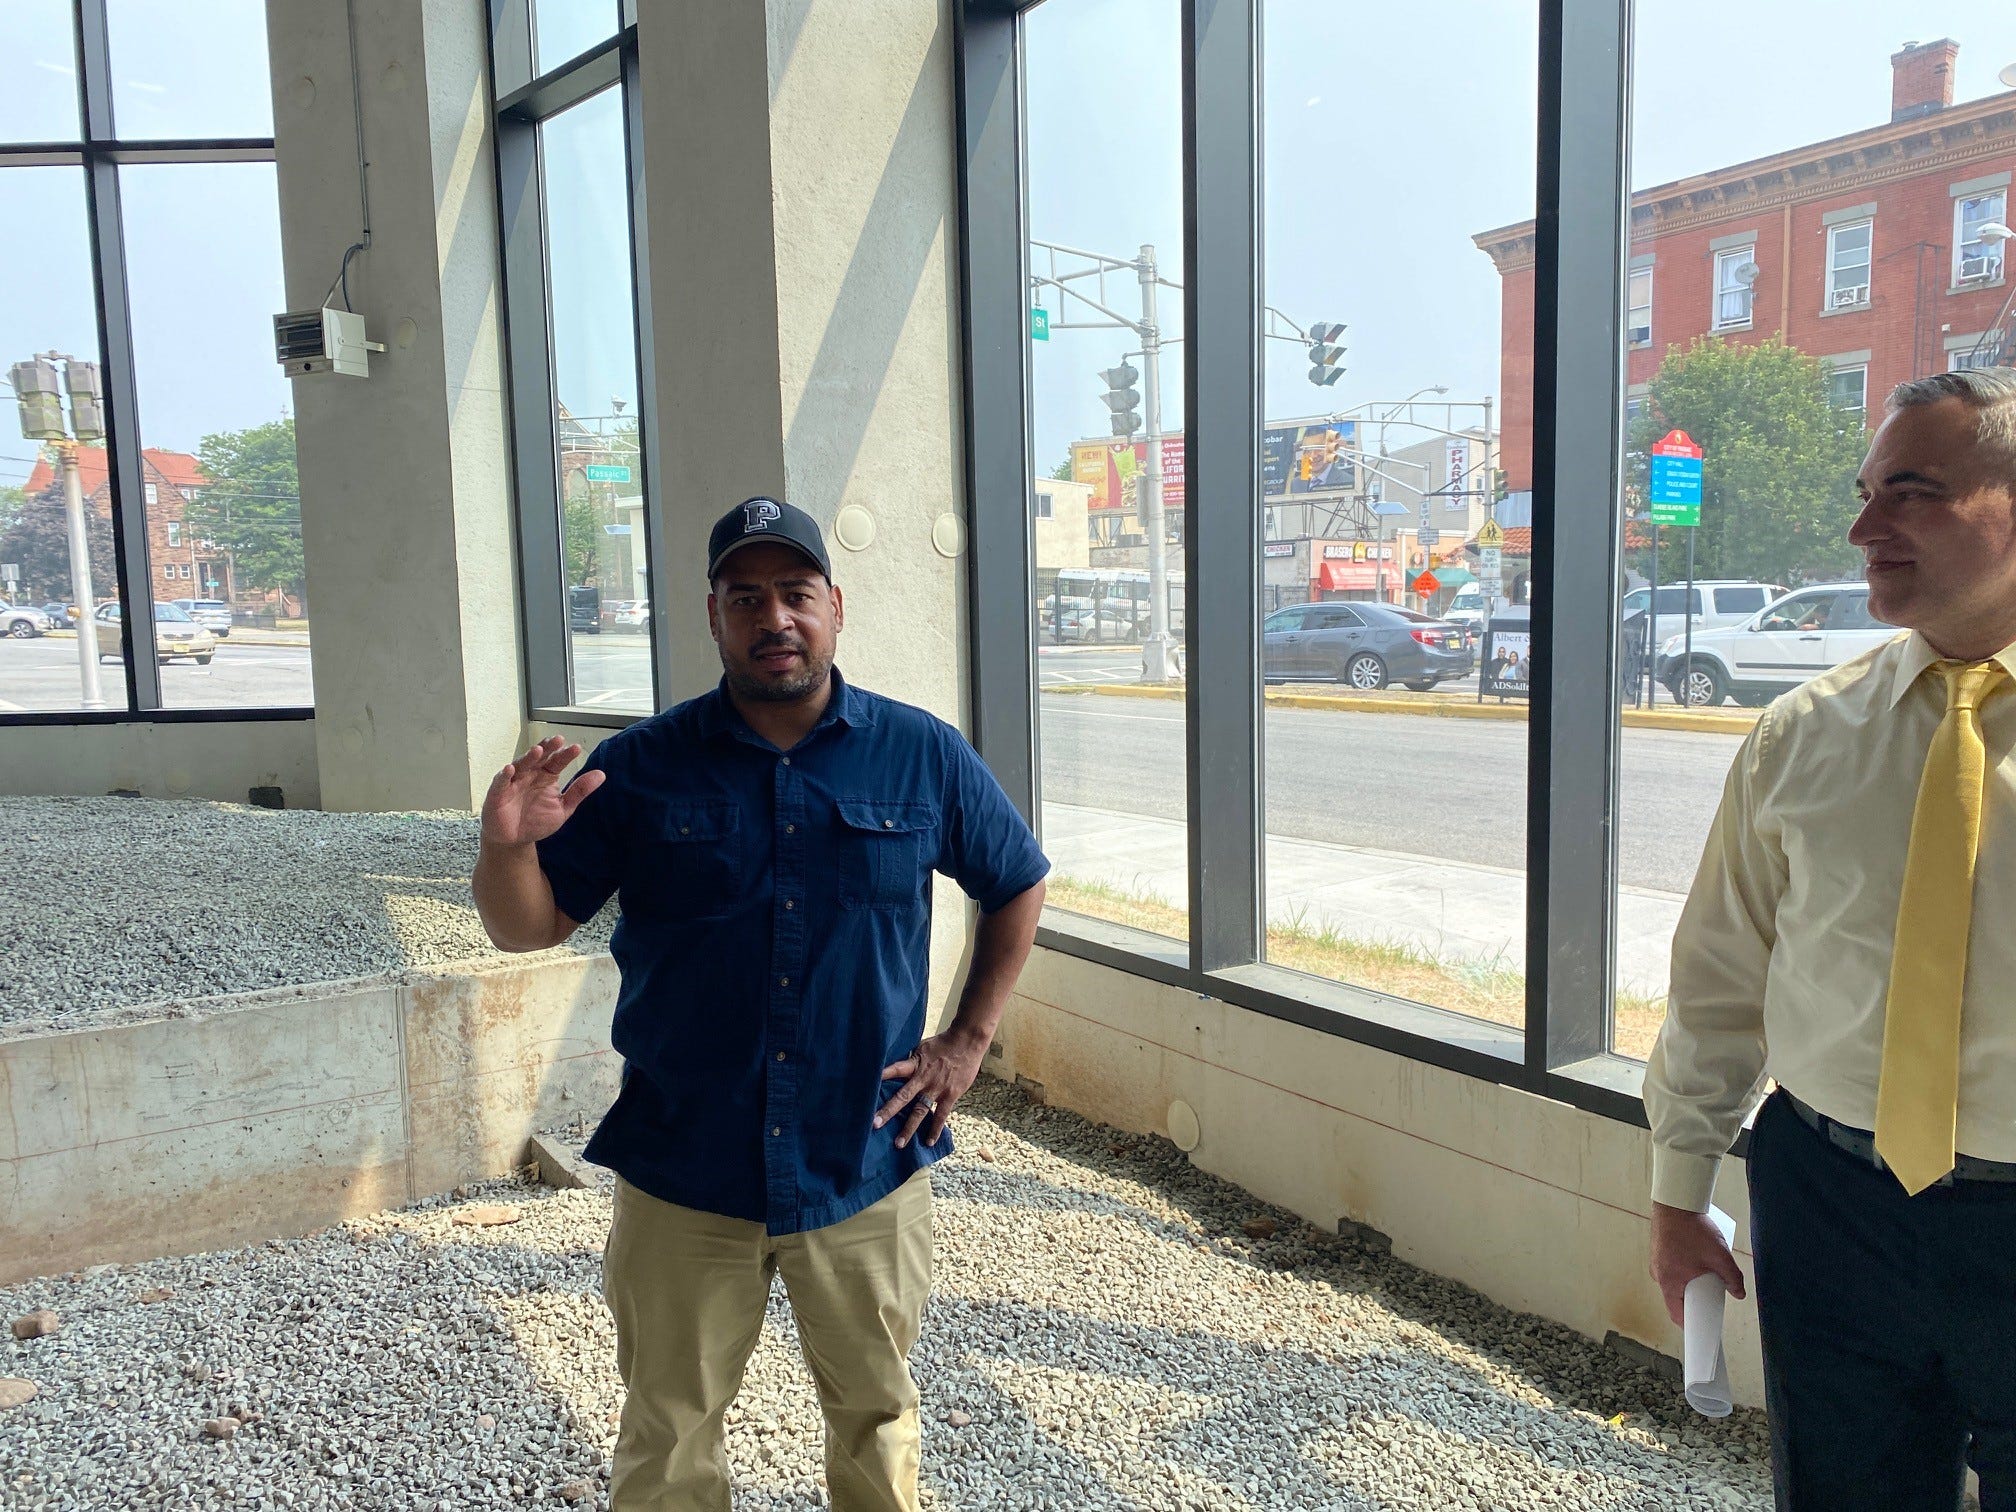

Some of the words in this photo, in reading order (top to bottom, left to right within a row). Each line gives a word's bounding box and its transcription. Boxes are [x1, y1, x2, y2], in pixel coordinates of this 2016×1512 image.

[1035, 316, 1046, 328] St
[590, 468, 620, 478] Passaic
[744, 500, 781, 533] P
[1325, 546, 1353, 559] BRASERO
[1494, 632, 1521, 642] Albert
